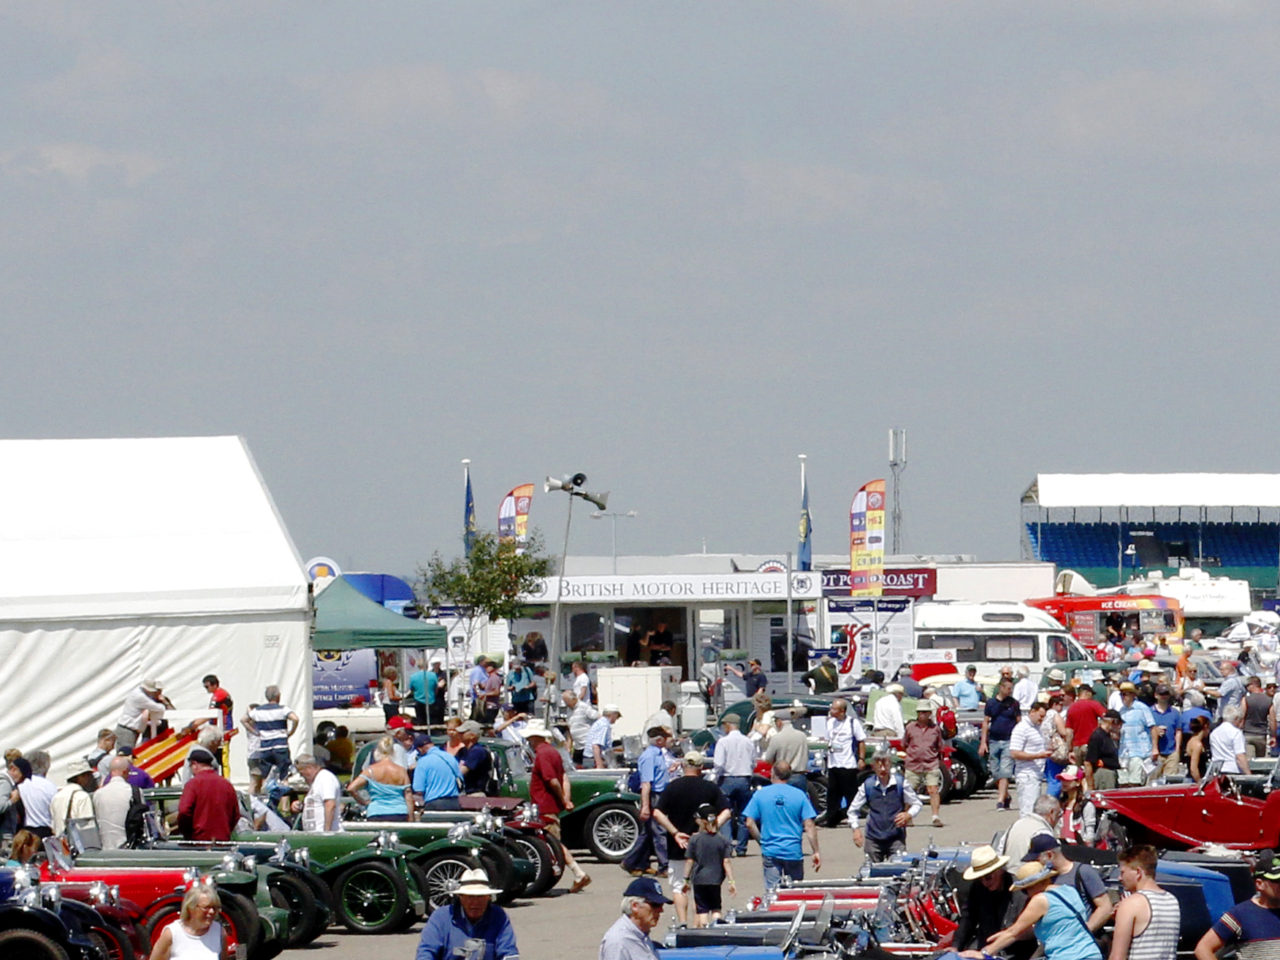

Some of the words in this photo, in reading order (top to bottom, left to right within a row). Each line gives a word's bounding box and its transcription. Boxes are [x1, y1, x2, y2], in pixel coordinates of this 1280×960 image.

[560, 579, 624, 598] BRITISH
[632, 580, 694, 596] MOTOR
[702, 580, 783, 596] HERITAGE
[1101, 601, 1113, 609] ICE
